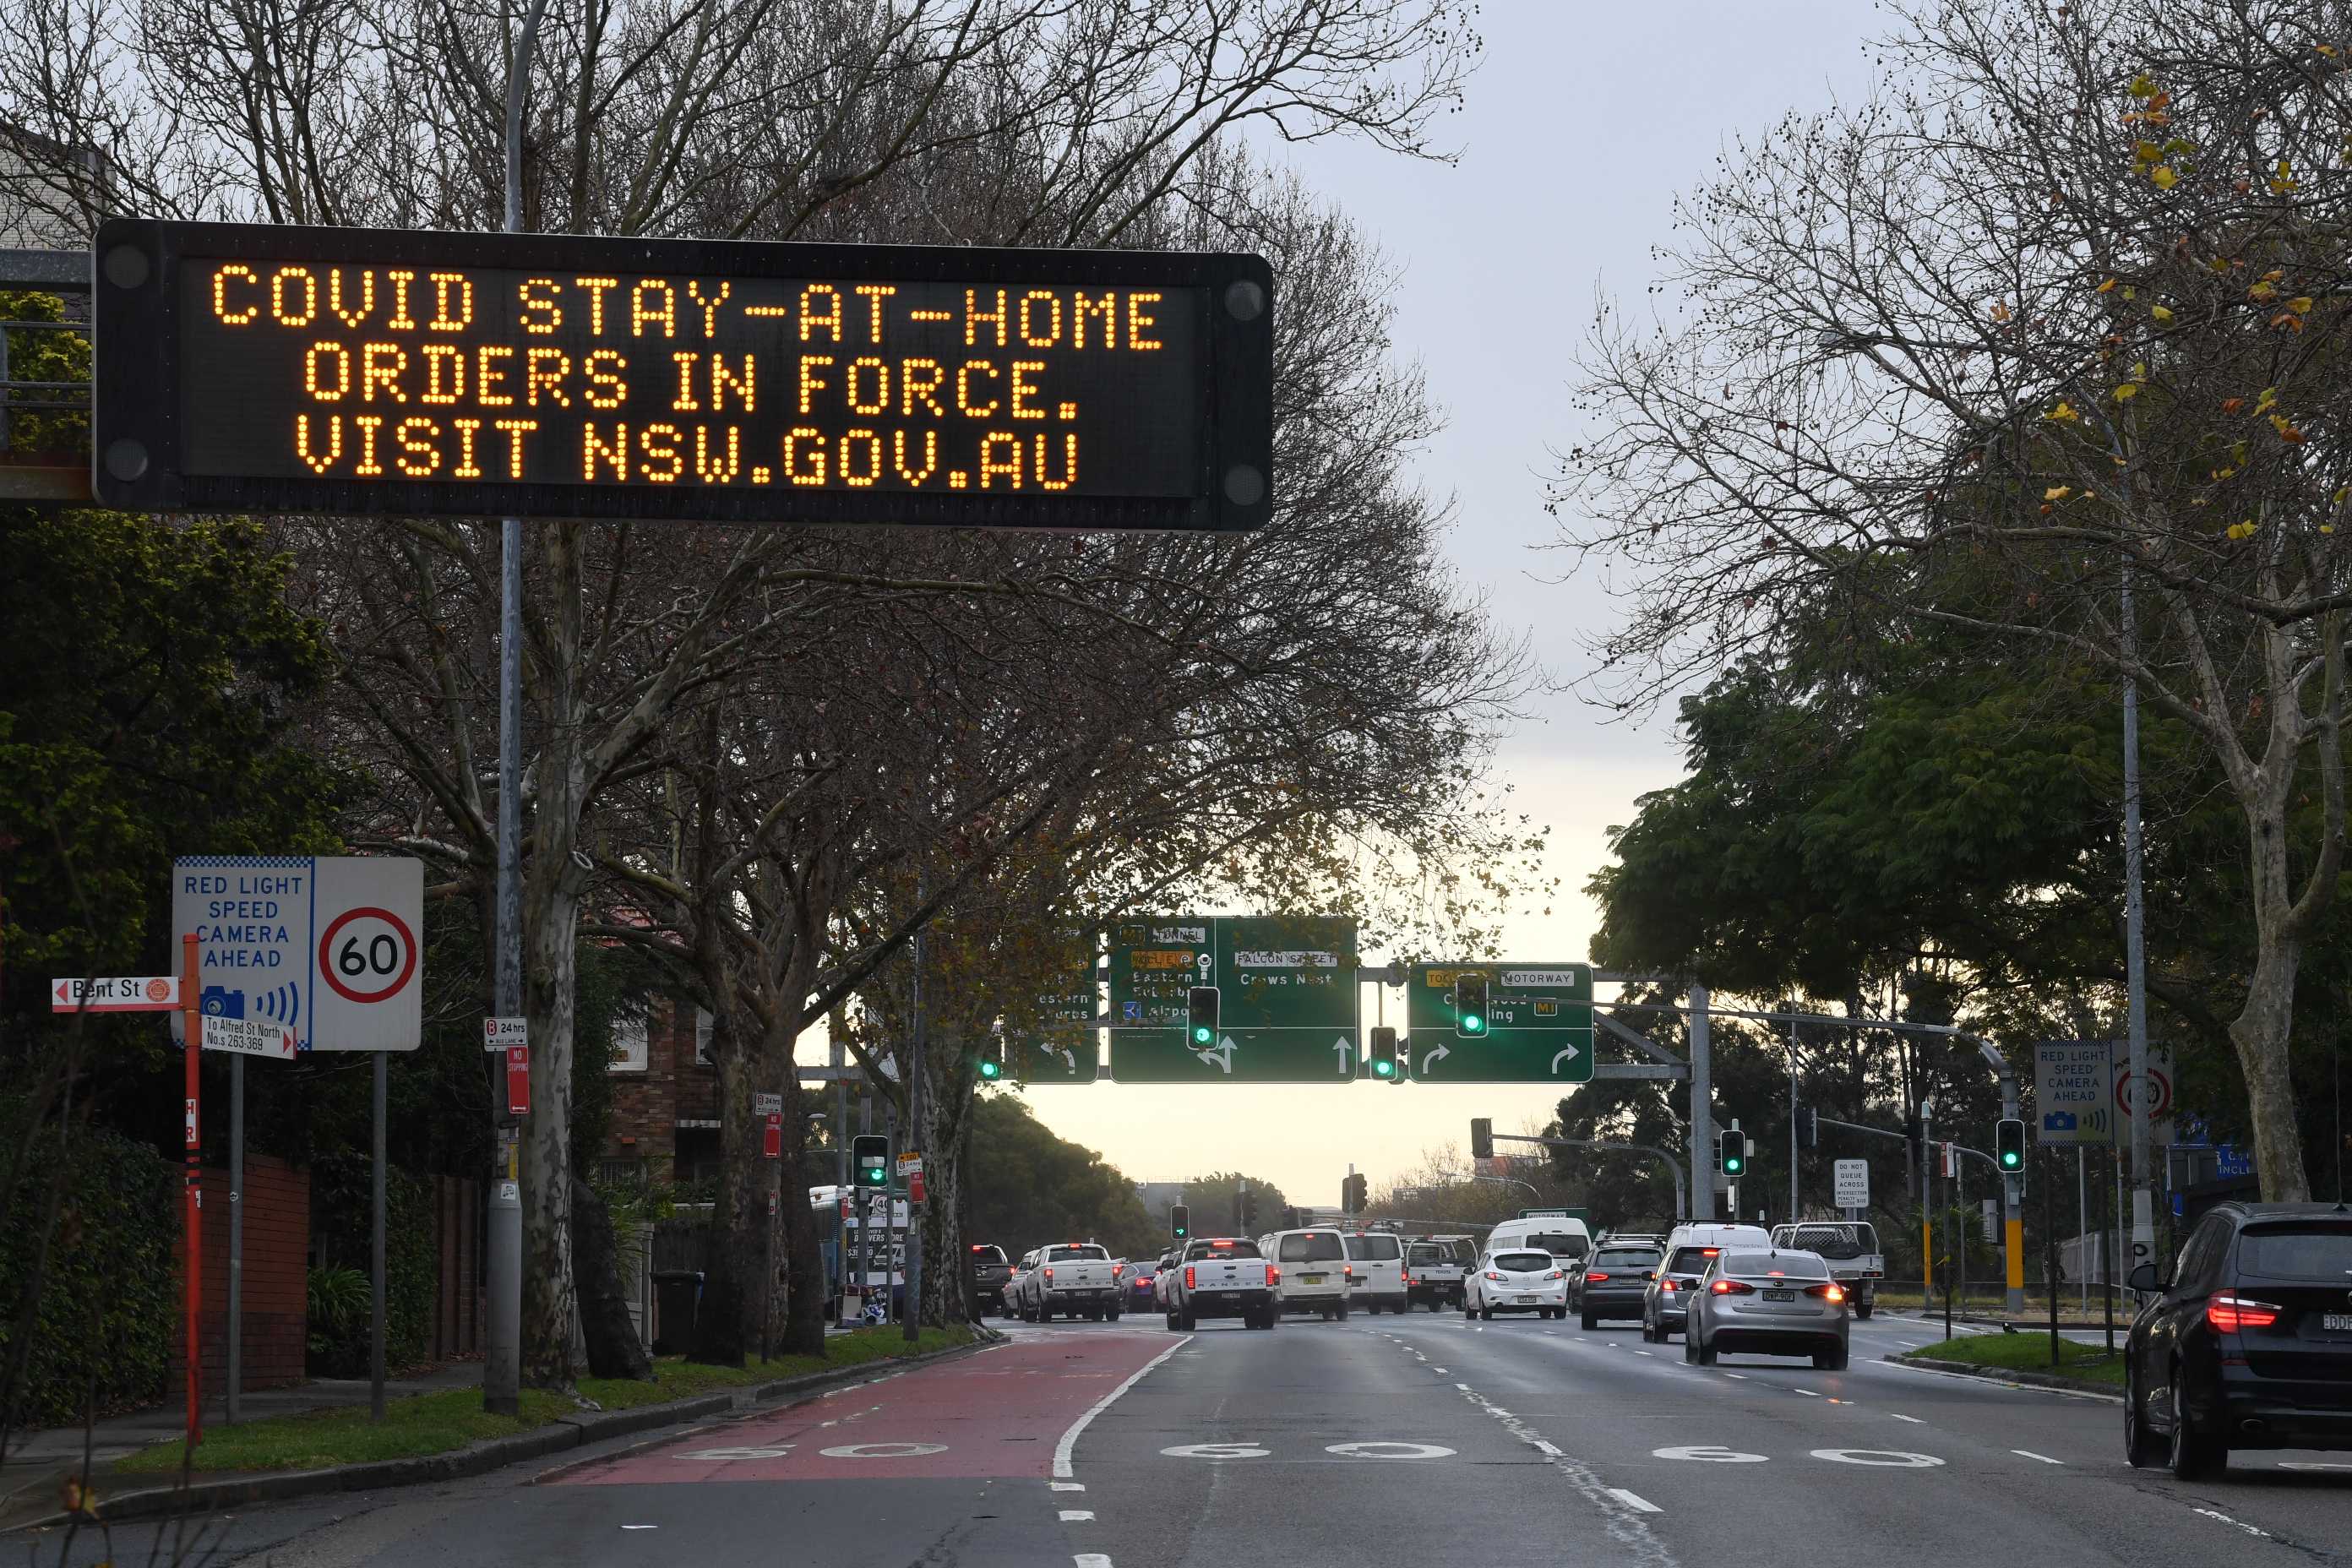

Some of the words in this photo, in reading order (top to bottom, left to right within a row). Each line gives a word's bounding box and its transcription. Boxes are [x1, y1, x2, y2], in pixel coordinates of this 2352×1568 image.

[214, 264, 472, 331] COVID
[520, 278, 1161, 350] STAY-AT-HOME
[306, 341, 627, 408] ORDERS
[672, 351, 754, 411] IN
[800, 355, 1075, 419] FORCE.
[297, 414, 537, 478] VISIT
[585, 422, 1076, 490] NSW.GOV.AU
[184, 877, 227, 894] RED
[240, 876, 302, 895] LIGHT
[209, 901, 278, 919] SPEED
[196, 925, 289, 944] CAMERA
[204, 950, 281, 967] AHEAD
[339, 934, 398, 976] 60
[1238, 955, 1283, 964] FALCON
[1289, 955, 1336, 964] STEET
[1240, 973, 1288, 985] Crws
[1296, 973, 1331, 985] Nst
[1503, 974, 1571, 983] MOTORWAY
[72, 980, 114, 999] Bent
[120, 980, 140, 998] St
[1035, 994, 1088, 1004] esrn
[1150, 1005, 1189, 1017] Airpo
[1487, 1009, 1514, 1023] ing
[207, 1016, 217, 1031] To
[220, 1019, 244, 1034] Alfred
[246, 1021, 255, 1036] St
[258, 1023, 280, 1039] North
[487, 1020, 496, 1036] B
[500, 1023, 512, 1033] 24
[513, 1023, 525, 1033] hrs
[207, 1031, 226, 1046] No.s
[227, 1034, 264, 1051] 263-369
[513, 1050, 522, 1060] NO
[2041, 1051, 2064, 1061] RED
[2071, 1050, 2104, 1061] LIGHT
[509, 1063, 528, 1072] STOPPING
[2055, 1064, 2093, 1075] SPEED
[2048, 1077, 2100, 1088] CAMERA
[2054, 1091, 2096, 1101] AHEAD
[2127, 1081, 2160, 1104] 0
